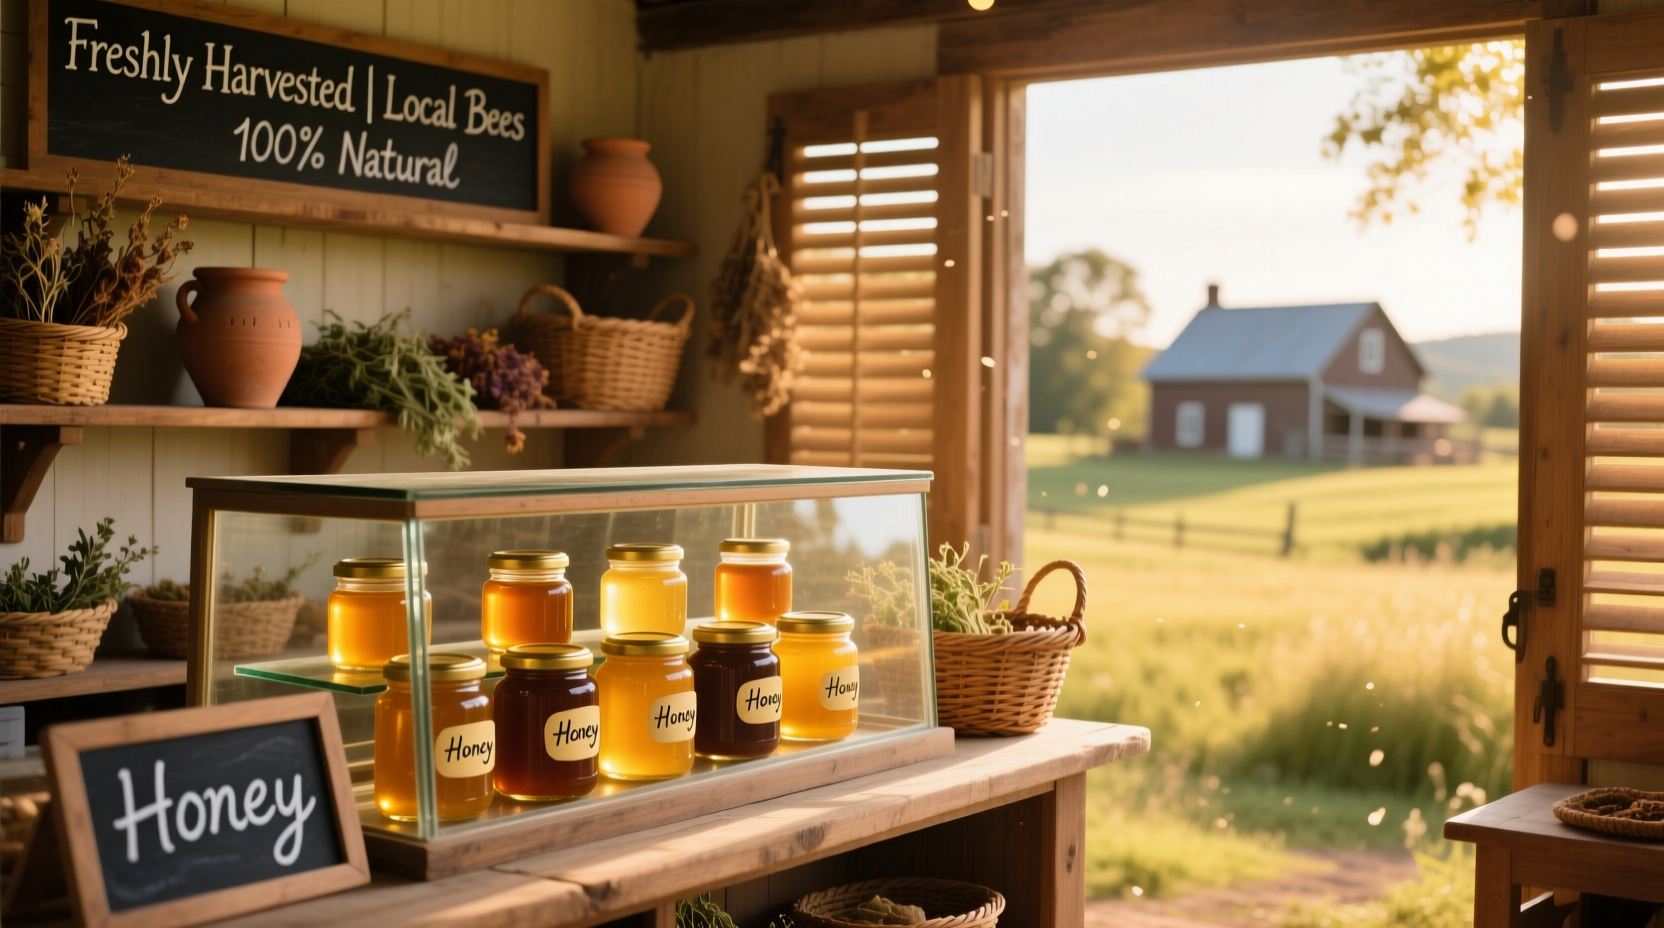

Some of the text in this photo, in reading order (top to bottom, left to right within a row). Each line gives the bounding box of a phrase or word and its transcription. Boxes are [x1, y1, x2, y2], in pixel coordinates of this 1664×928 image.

[64, 17, 194, 105] Freshly
[201, 42, 355, 113] Harvested
[383, 74, 457, 130] Local
[464, 88, 525, 142] Bees
[233, 117, 460, 190] 100% Natural
[444, 735, 493, 765] Honey
[553, 719, 599, 749] Honey
[113, 759, 317, 866] Honey
